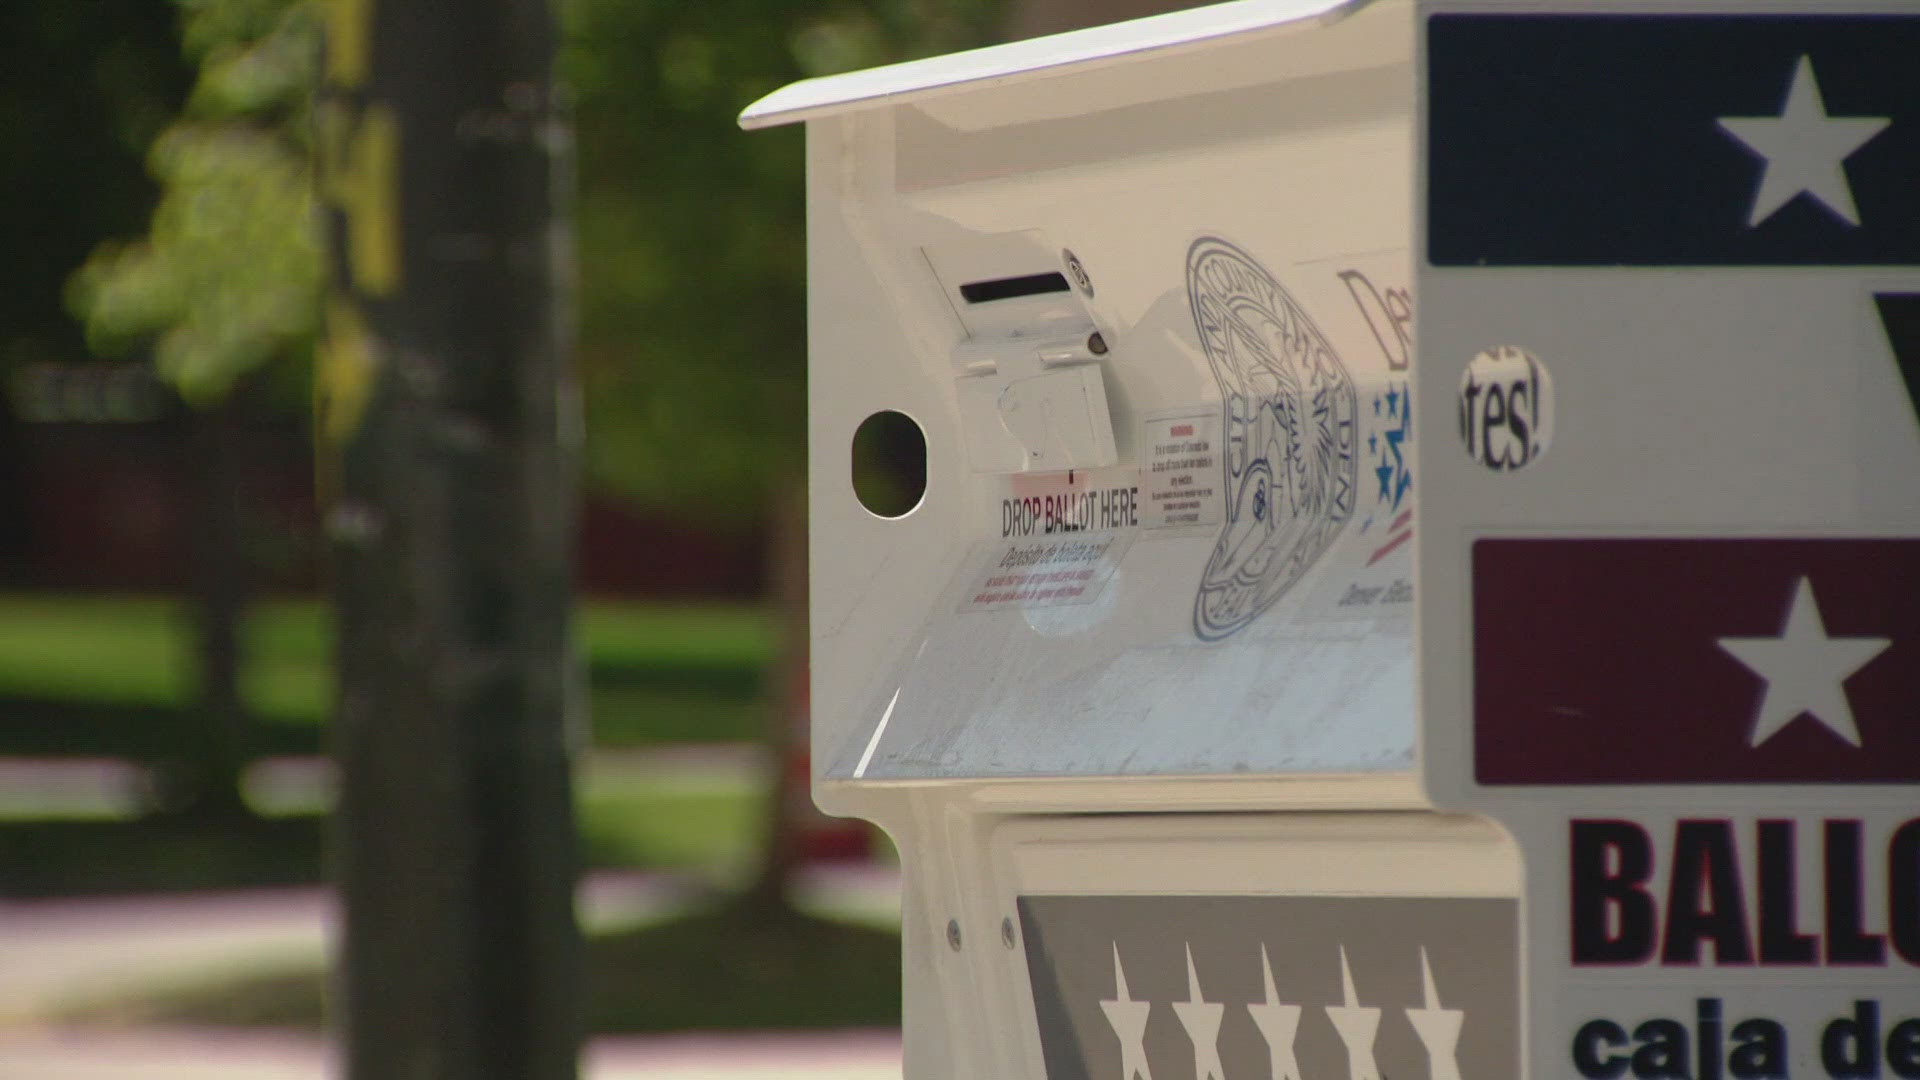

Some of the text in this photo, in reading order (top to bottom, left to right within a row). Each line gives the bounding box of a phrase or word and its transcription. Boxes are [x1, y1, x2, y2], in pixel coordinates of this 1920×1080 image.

[1002, 487, 1138, 538] DROP BALLOT HERE
[1572, 998, 1790, 1080] caja
